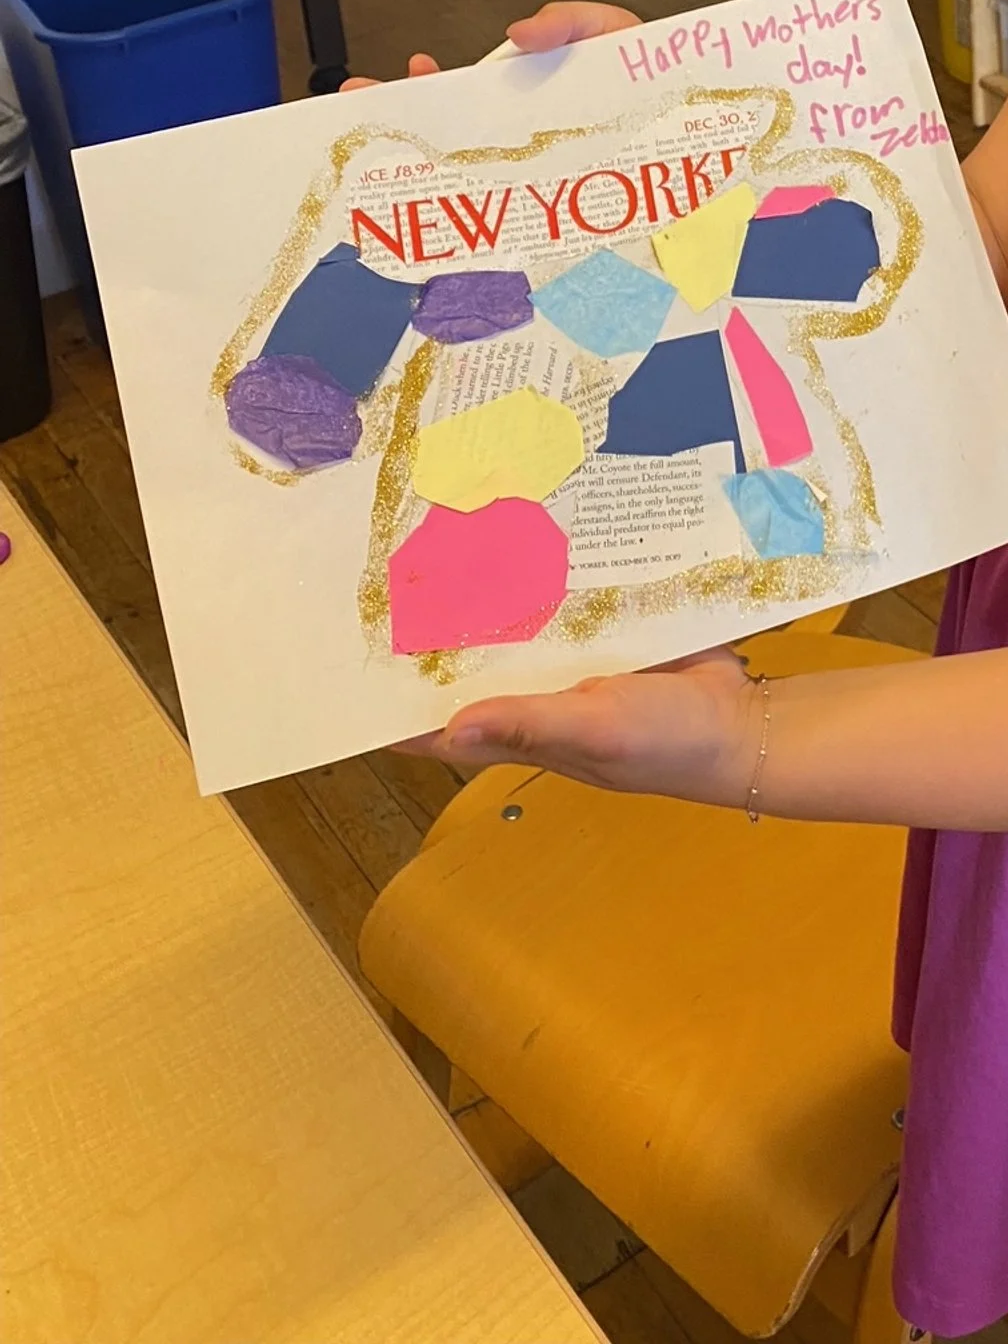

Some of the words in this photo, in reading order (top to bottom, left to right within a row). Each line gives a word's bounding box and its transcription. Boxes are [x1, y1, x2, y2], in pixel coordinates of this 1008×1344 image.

[787, 34, 866, 89] day!
[809, 96, 904, 143] from
[351, 187, 512, 265] NEW
[491, 362, 506, 387] Little
[502, 354, 521, 388] climbed
[542, 348, 560, 385] Harvard
[462, 367, 479, 400] learned
[582, 465, 598, 474] Mr.
[600, 462, 632, 476] Coyote
[634, 461, 648, 471] the
[650, 459, 664, 469] full
[667, 457, 702, 468] amount,
[588, 478, 604, 487] will
[607, 476, 638, 485] censure
[642, 470, 690, 482] Defendant,
[582, 488, 615, 500] officers,
[616, 483, 671, 497] shareholders,
[582, 502, 614, 515] assigns,
[616, 501, 625, 509] in
[628, 499, 642, 507] the
[645, 497, 663, 507] only
[665, 493, 704, 505] language
[614, 513, 630, 522] and
[632, 509, 666, 520] reaffirm
[668, 507, 681, 516] the
[684, 505, 704, 517] right
[614, 524, 650, 536] predator
[663, 520, 685, 532] equal
[576, 541, 601, 551] under
[604, 539, 618, 548] the
[620, 537, 637, 546] law.
